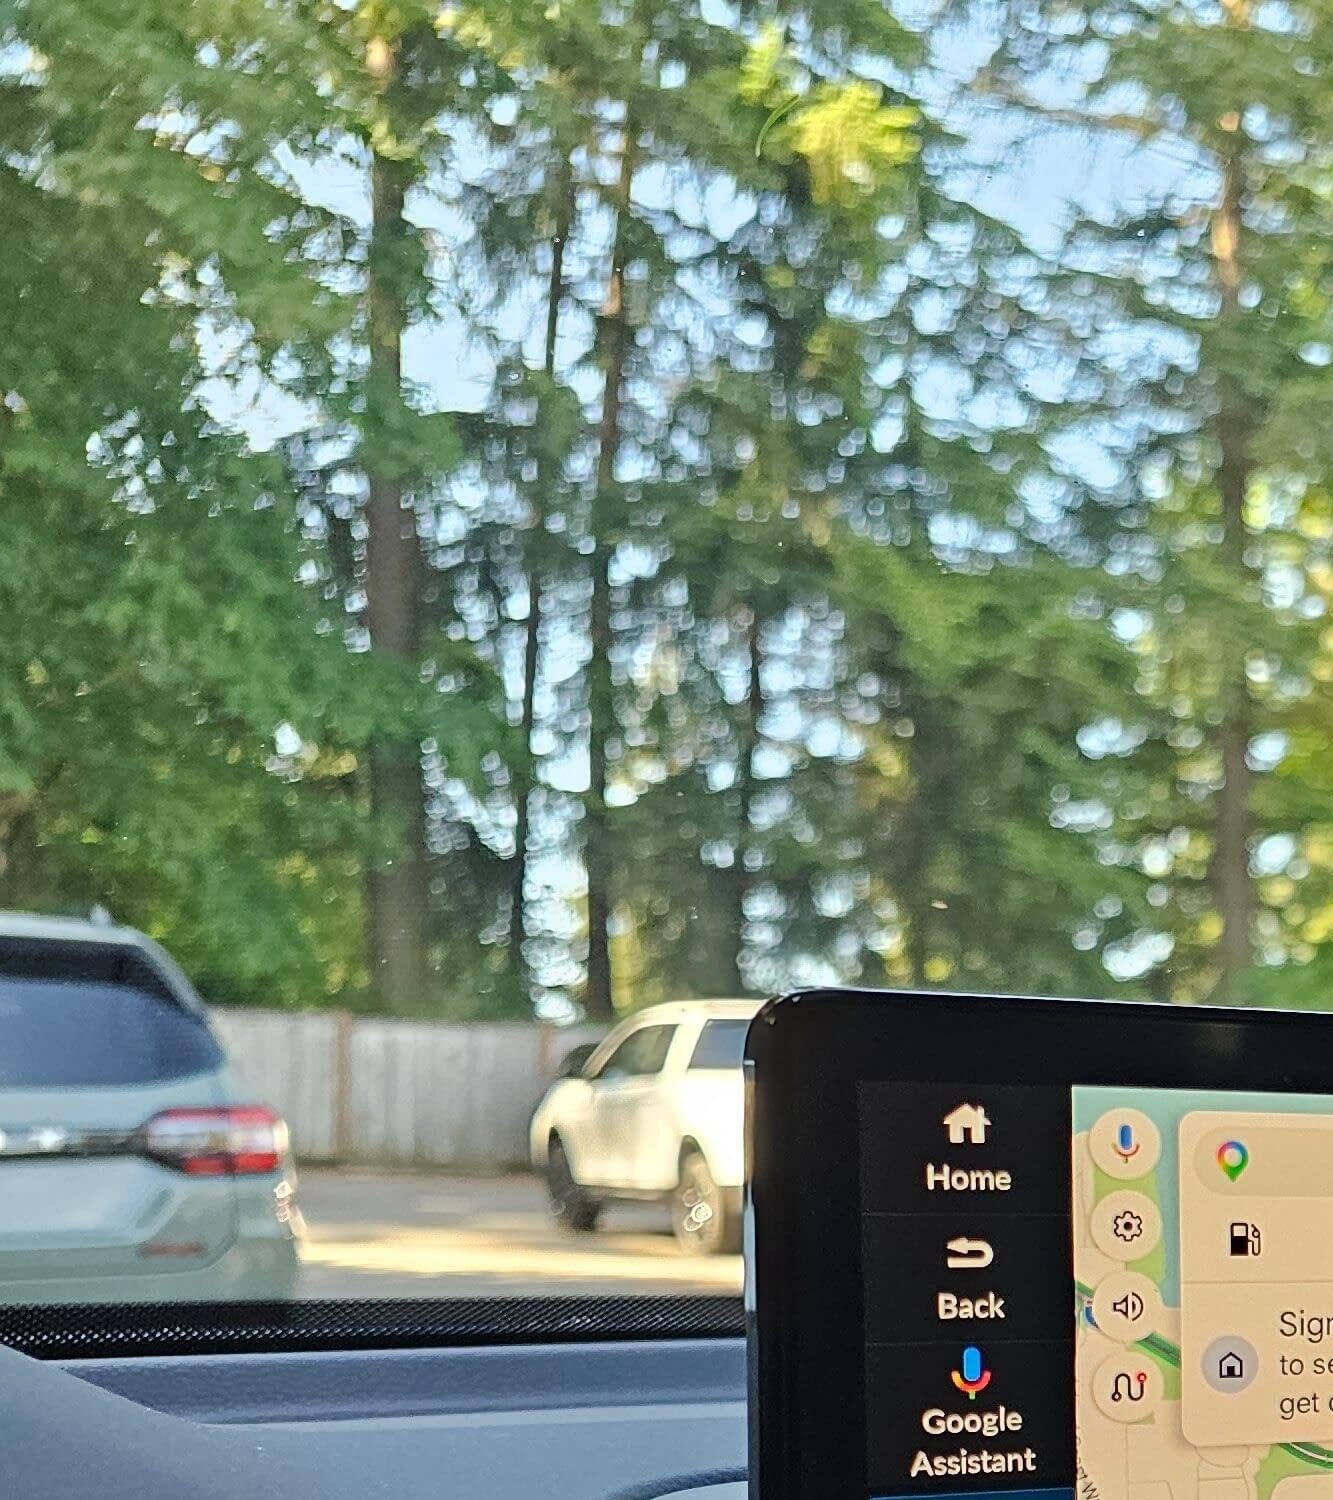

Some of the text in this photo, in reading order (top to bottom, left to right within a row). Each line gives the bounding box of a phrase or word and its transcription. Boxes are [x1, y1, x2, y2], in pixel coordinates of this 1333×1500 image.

[926, 1163, 1012, 1191] Home
[937, 1291, 1006, 1320] Back
[1280, 1354, 1305, 1376] to
[1280, 1391, 1320, 1420] get
[921, 1405, 1023, 1438] Google
[910, 1447, 1036, 1478] Assistant
